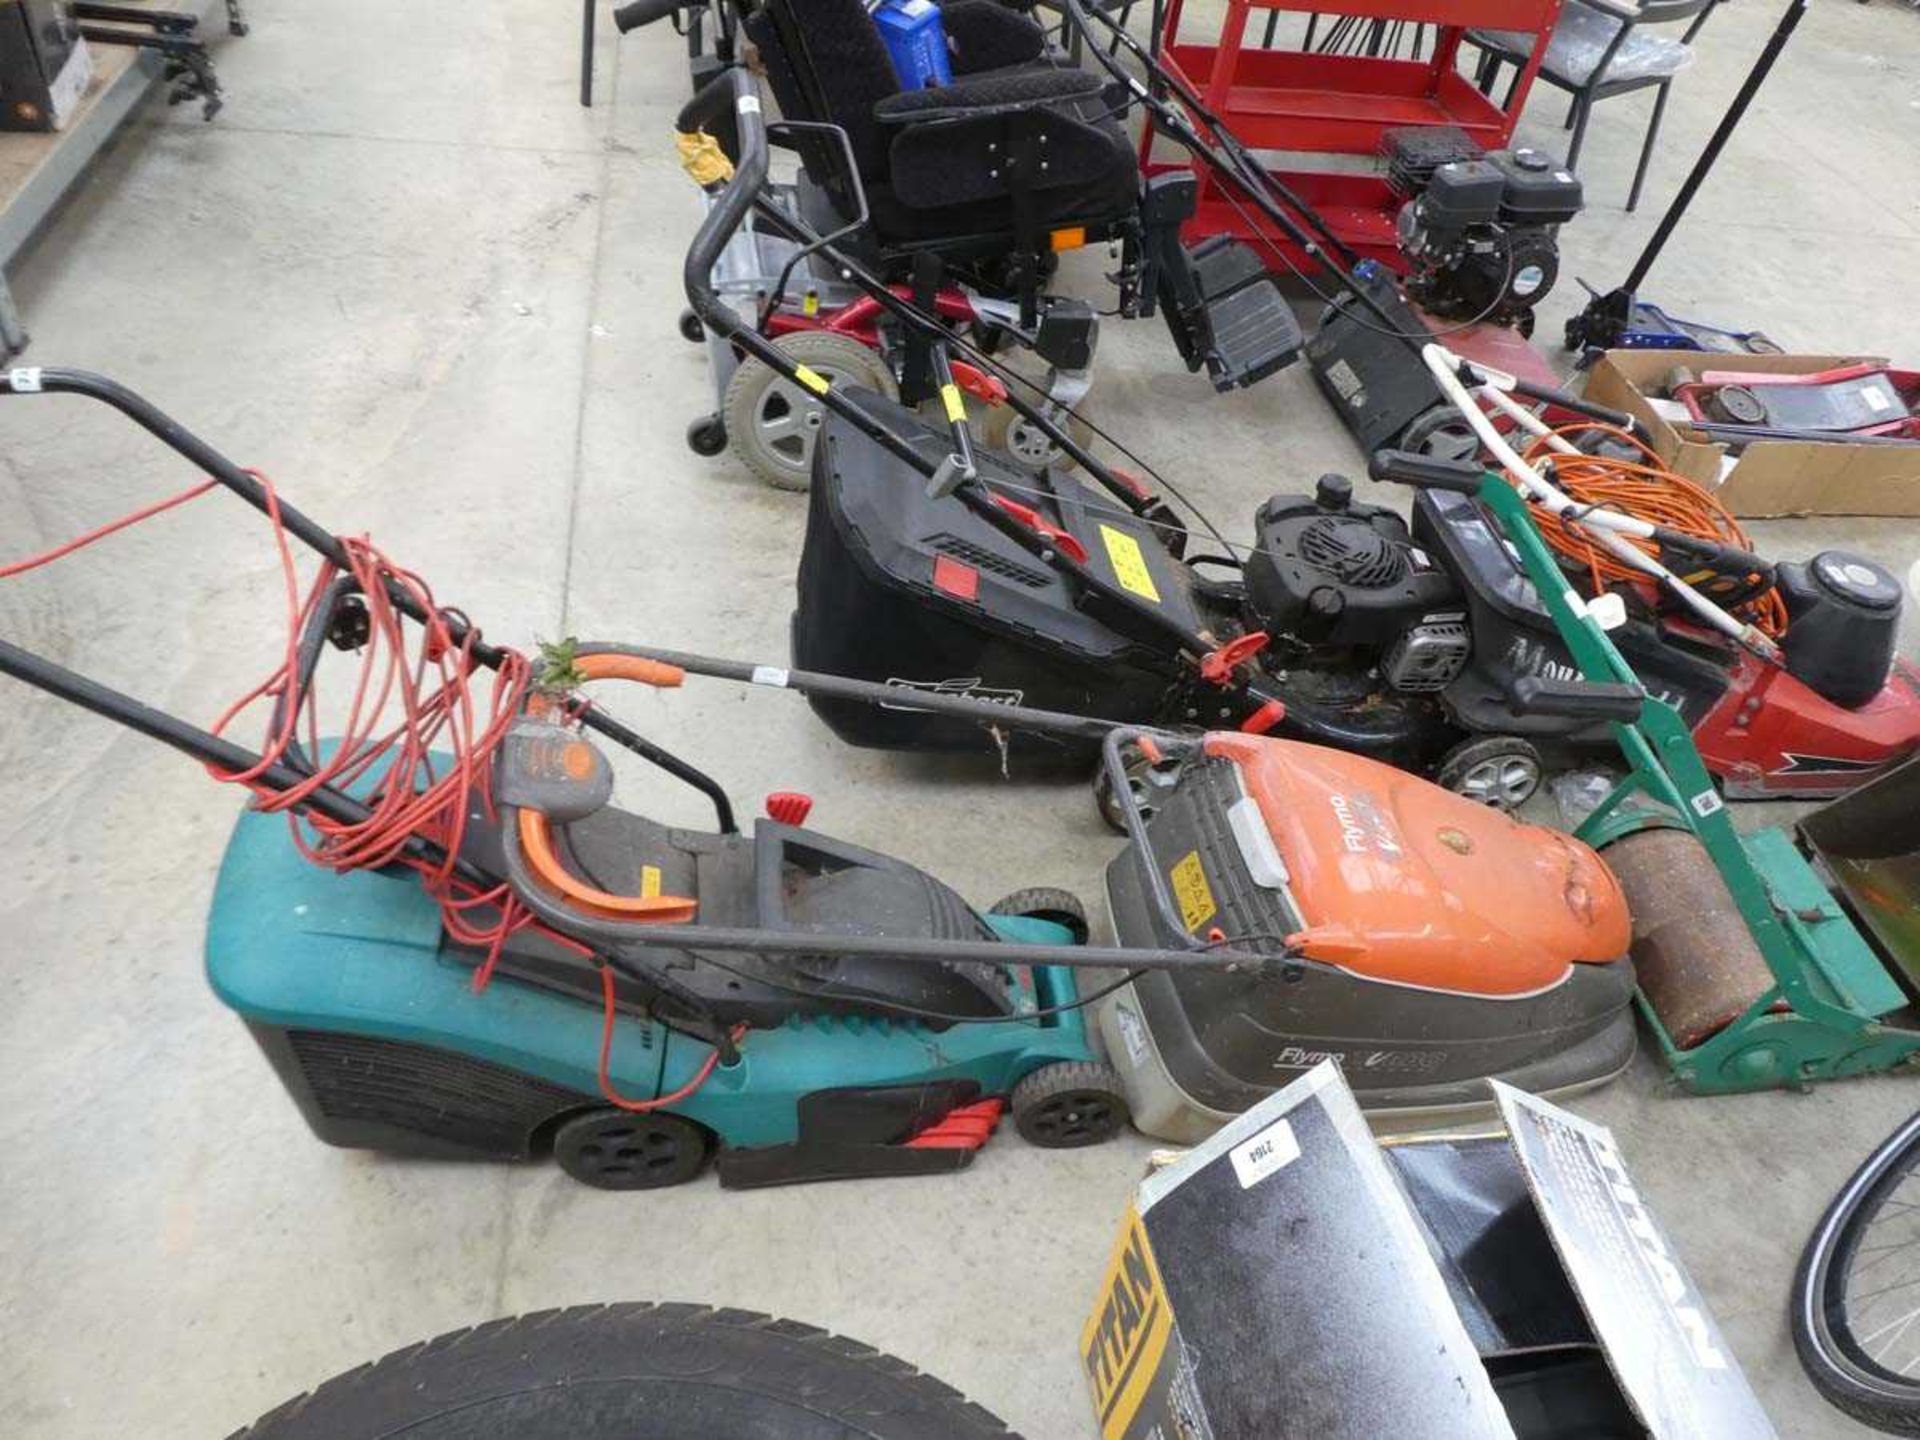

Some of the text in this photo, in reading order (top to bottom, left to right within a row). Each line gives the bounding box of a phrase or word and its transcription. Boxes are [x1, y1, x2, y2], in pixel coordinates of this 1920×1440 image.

[1330, 794, 1367, 853] Flymo
[1249, 1139, 1274, 1163] 2164
[1086, 1222, 1153, 1407] TITAN
